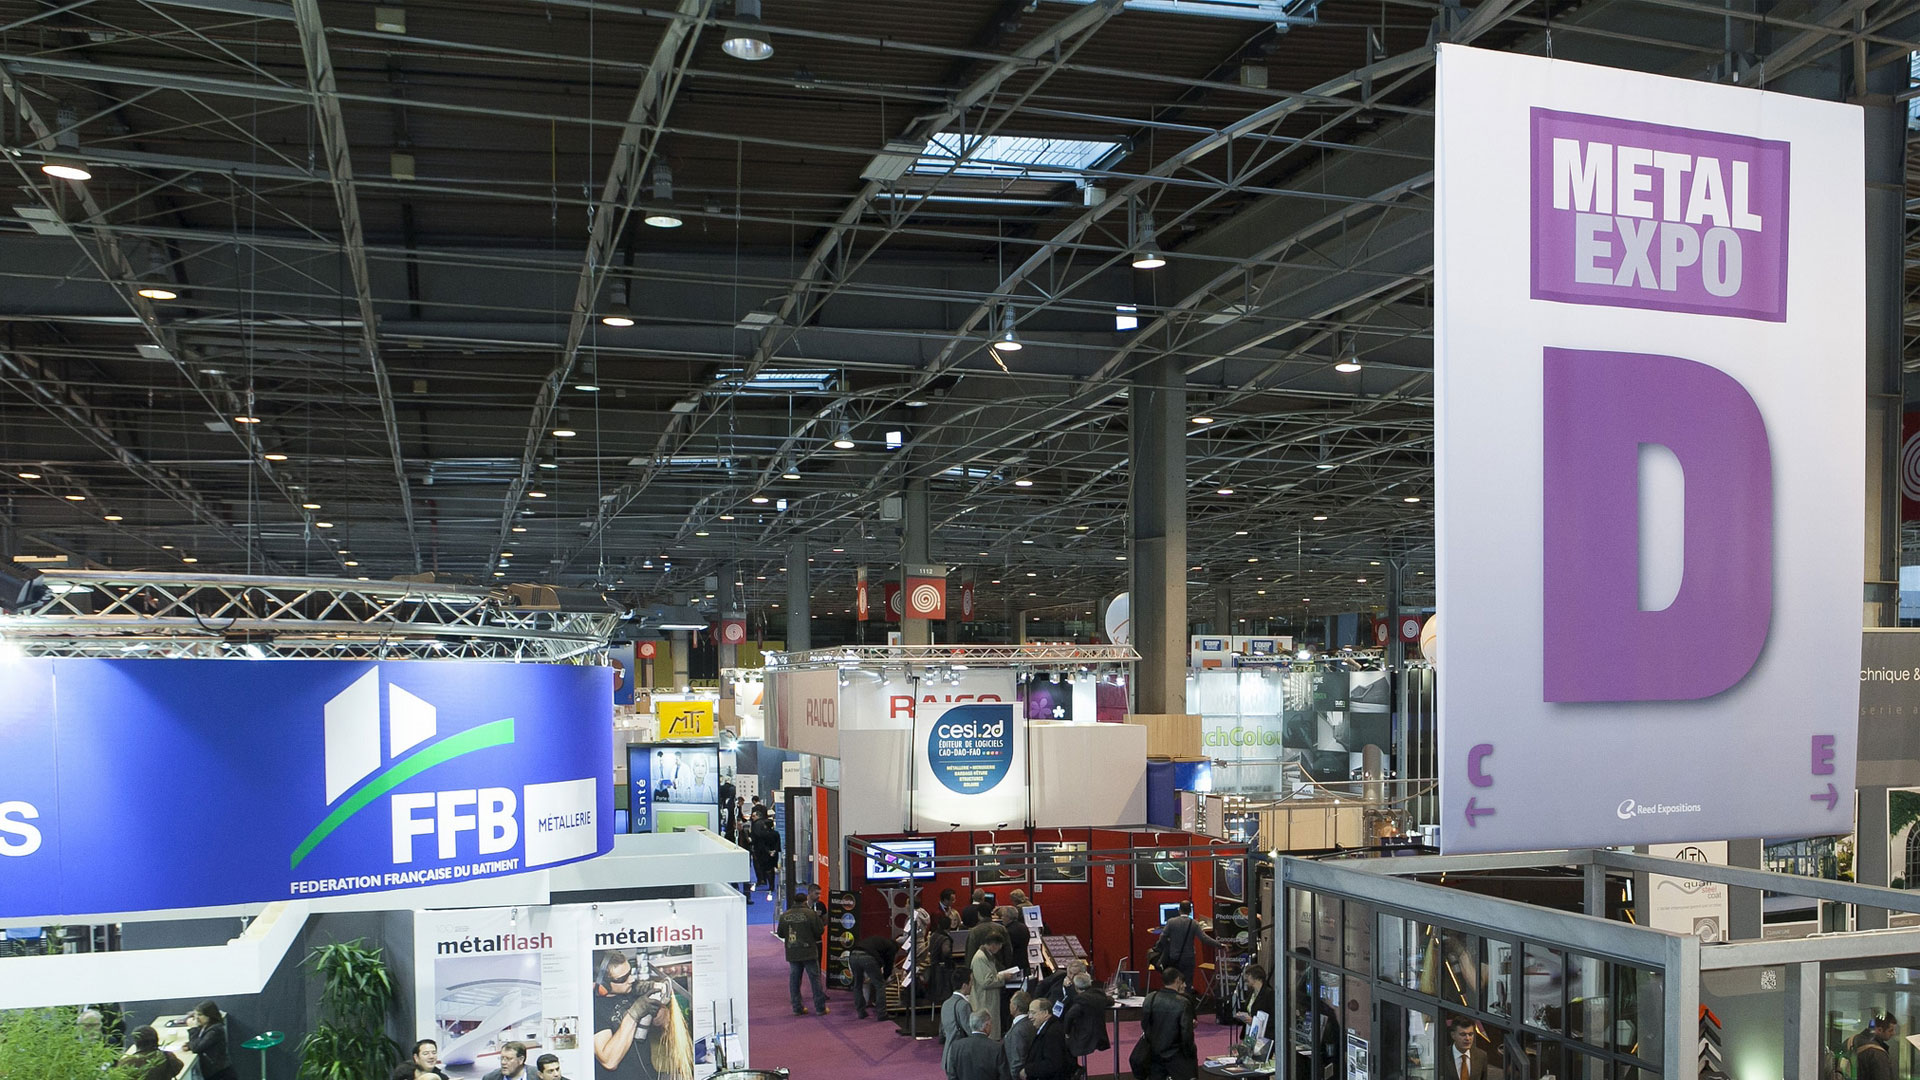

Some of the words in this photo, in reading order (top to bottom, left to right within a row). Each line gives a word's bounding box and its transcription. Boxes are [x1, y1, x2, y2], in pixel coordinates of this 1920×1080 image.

[1553, 137, 1762, 232] METAL
[1575, 212, 1743, 298] EXPO
[1543, 346, 1772, 702] D
[806, 698, 835, 728] RAICO
[938, 719, 1004, 739] cesi.2d
[939, 739, 963, 749] ÉDITEUR
[965, 740, 973, 748] DE
[975, 740, 1004, 749] LOGICIELS
[1811, 735, 1835, 775] E
[1467, 743, 1494, 788] C
[636, 779, 647, 826] Santé
[1637, 804, 1656, 815] Reed
[1657, 802, 1702, 816] Expositions
[391, 786, 519, 864] FFB
[538, 811, 591, 833] MÉTALLERIE
[290, 874, 381, 895] FEDERATION
[384, 867, 452, 886] FRANÇAISE
[453, 864, 471, 878] DU
[472, 858, 520, 875] BATIMENT
[437, 932, 553, 955] métalflash
[595, 924, 703, 947] métalflash
